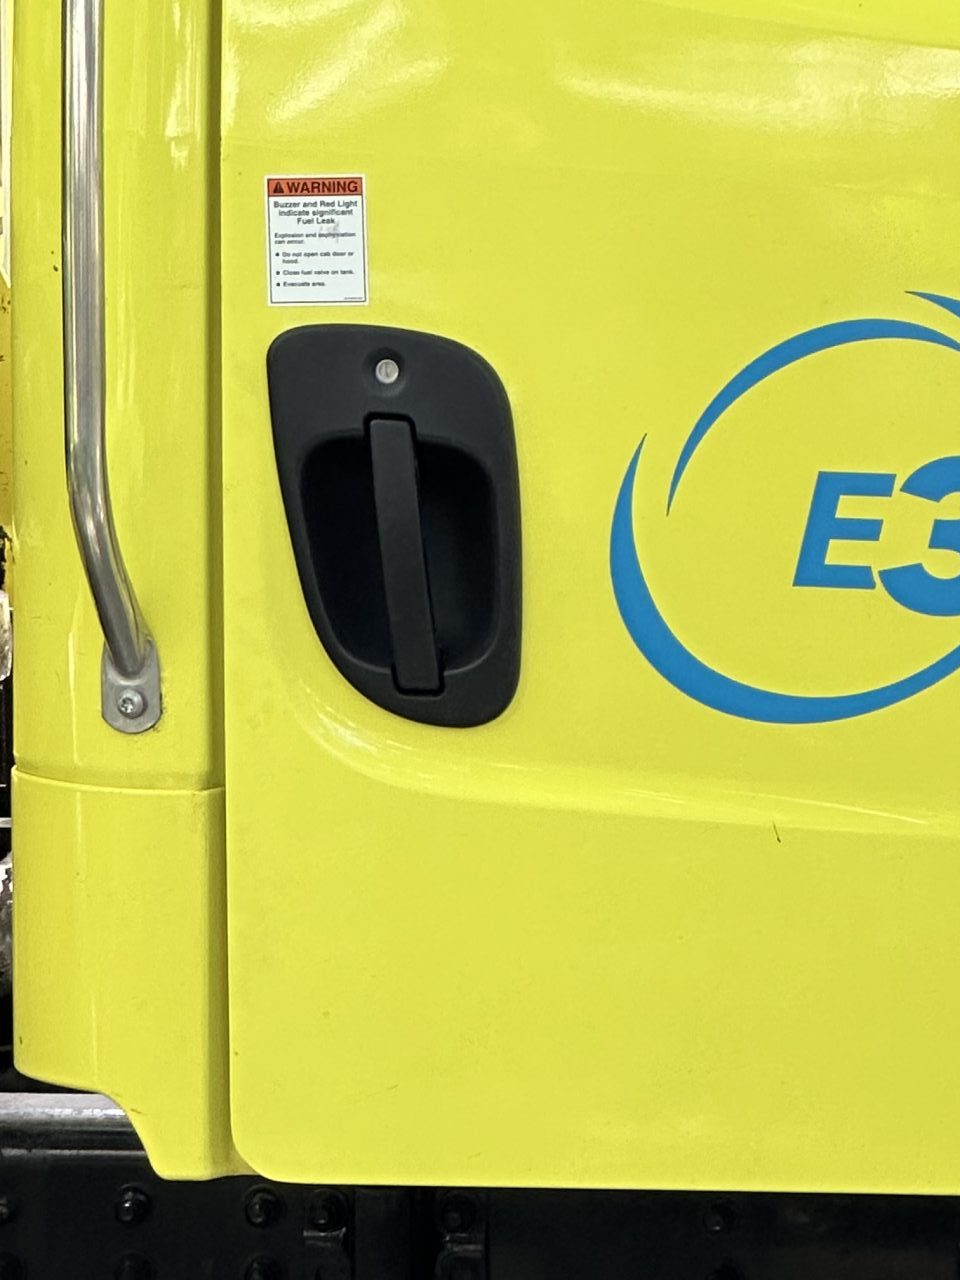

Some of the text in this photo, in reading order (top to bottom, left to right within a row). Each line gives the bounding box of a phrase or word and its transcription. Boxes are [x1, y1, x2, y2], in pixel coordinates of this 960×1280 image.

[286, 180, 358, 193] WARNING
[337, 200, 358, 209] Light
[312, 209, 353, 217] significant
